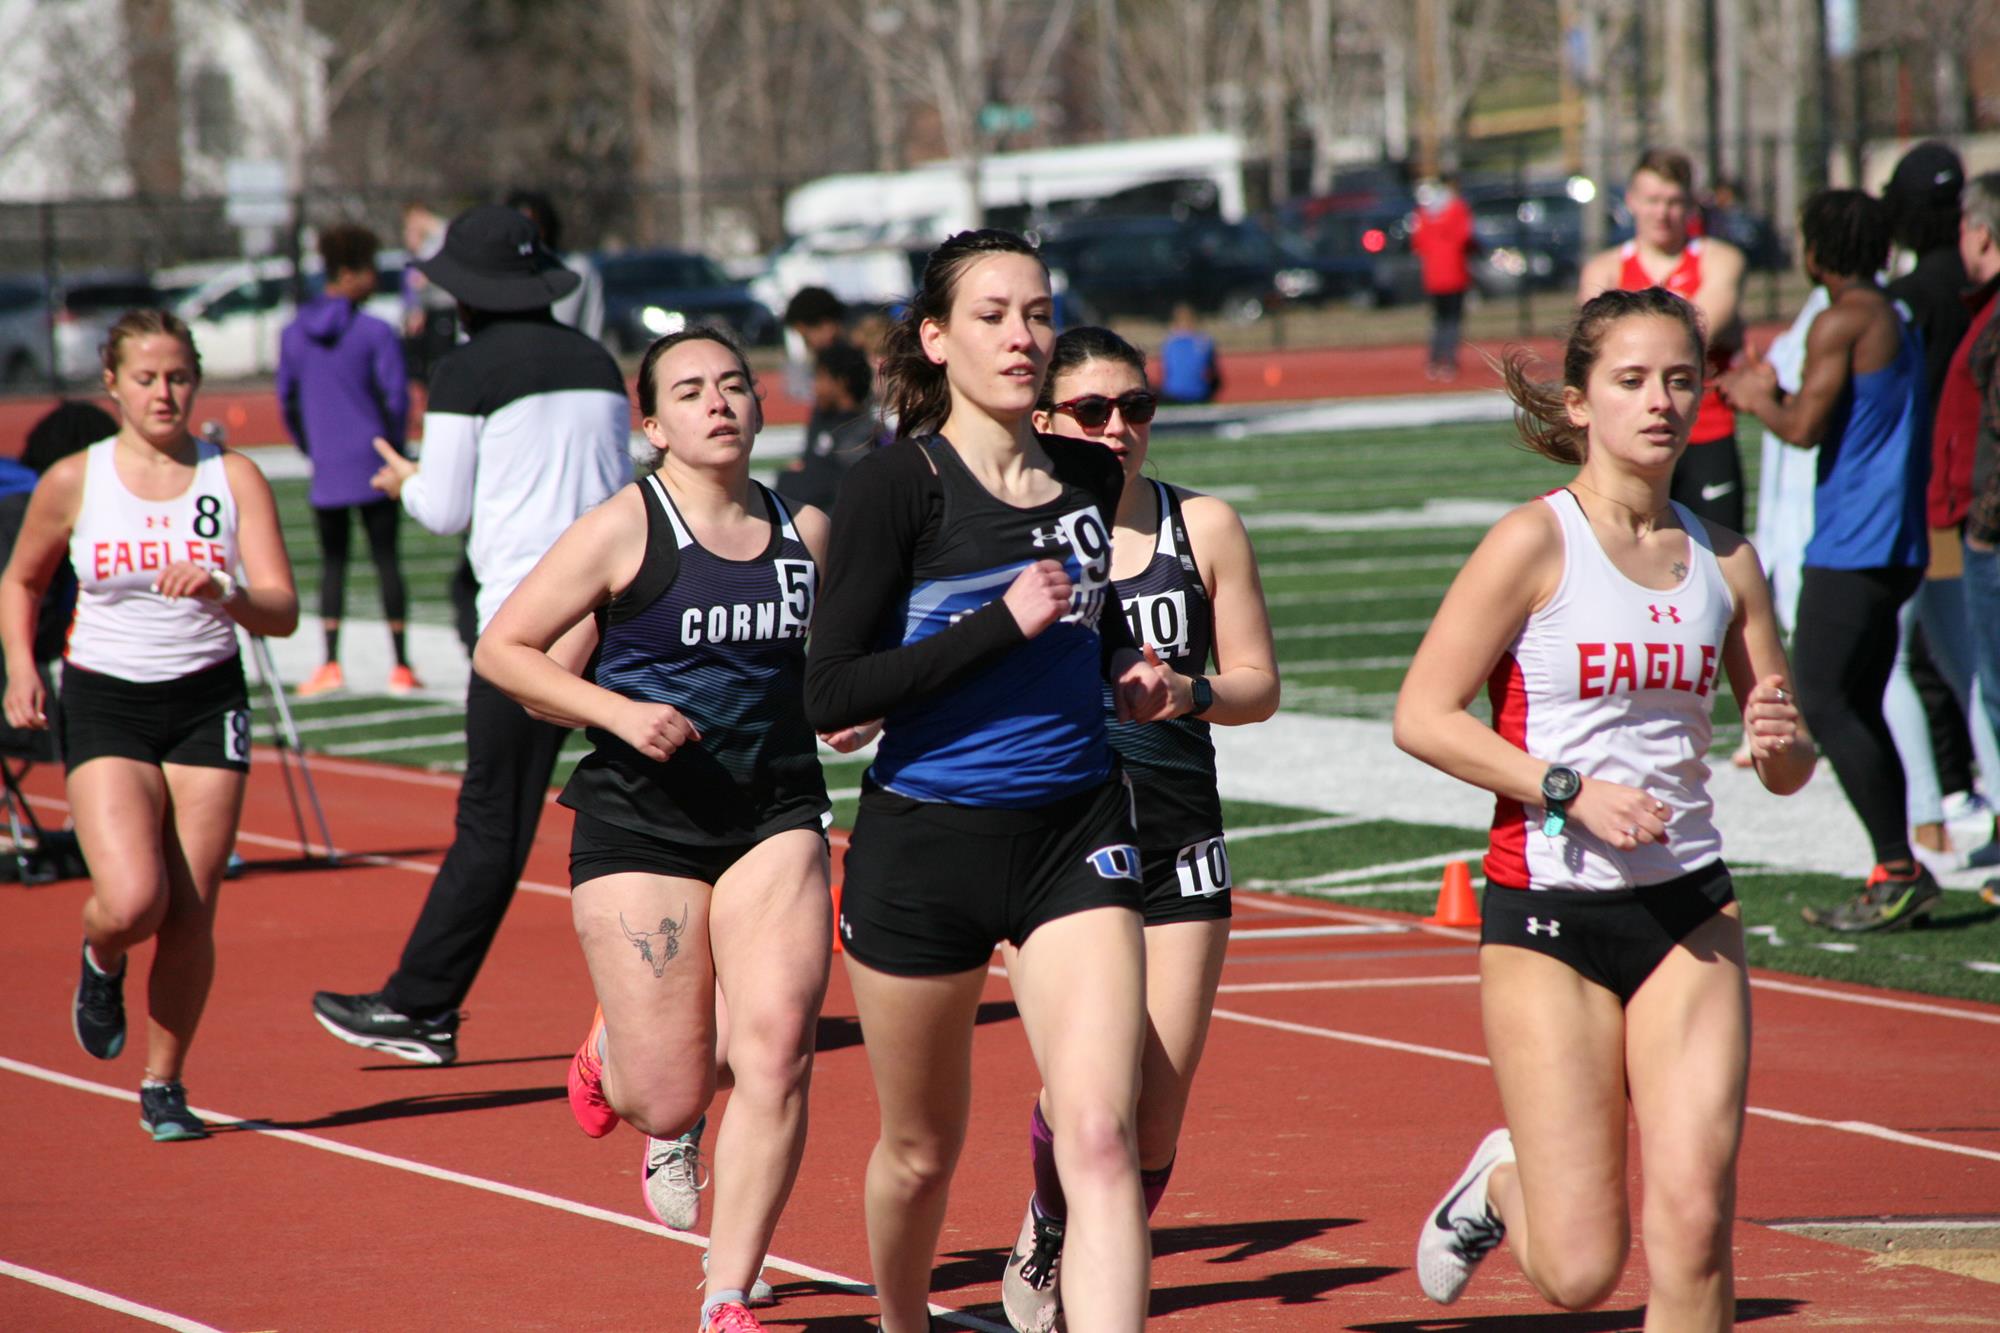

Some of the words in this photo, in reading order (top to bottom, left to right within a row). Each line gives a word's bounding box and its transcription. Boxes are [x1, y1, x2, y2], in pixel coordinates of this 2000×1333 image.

[193, 495, 220, 539] 8
[1074, 514, 1111, 583] 9
[784, 564, 810, 621] 5
[1123, 597, 1178, 646] 10
[232, 711, 250, 757] 8
[1181, 841, 1226, 892] 10
